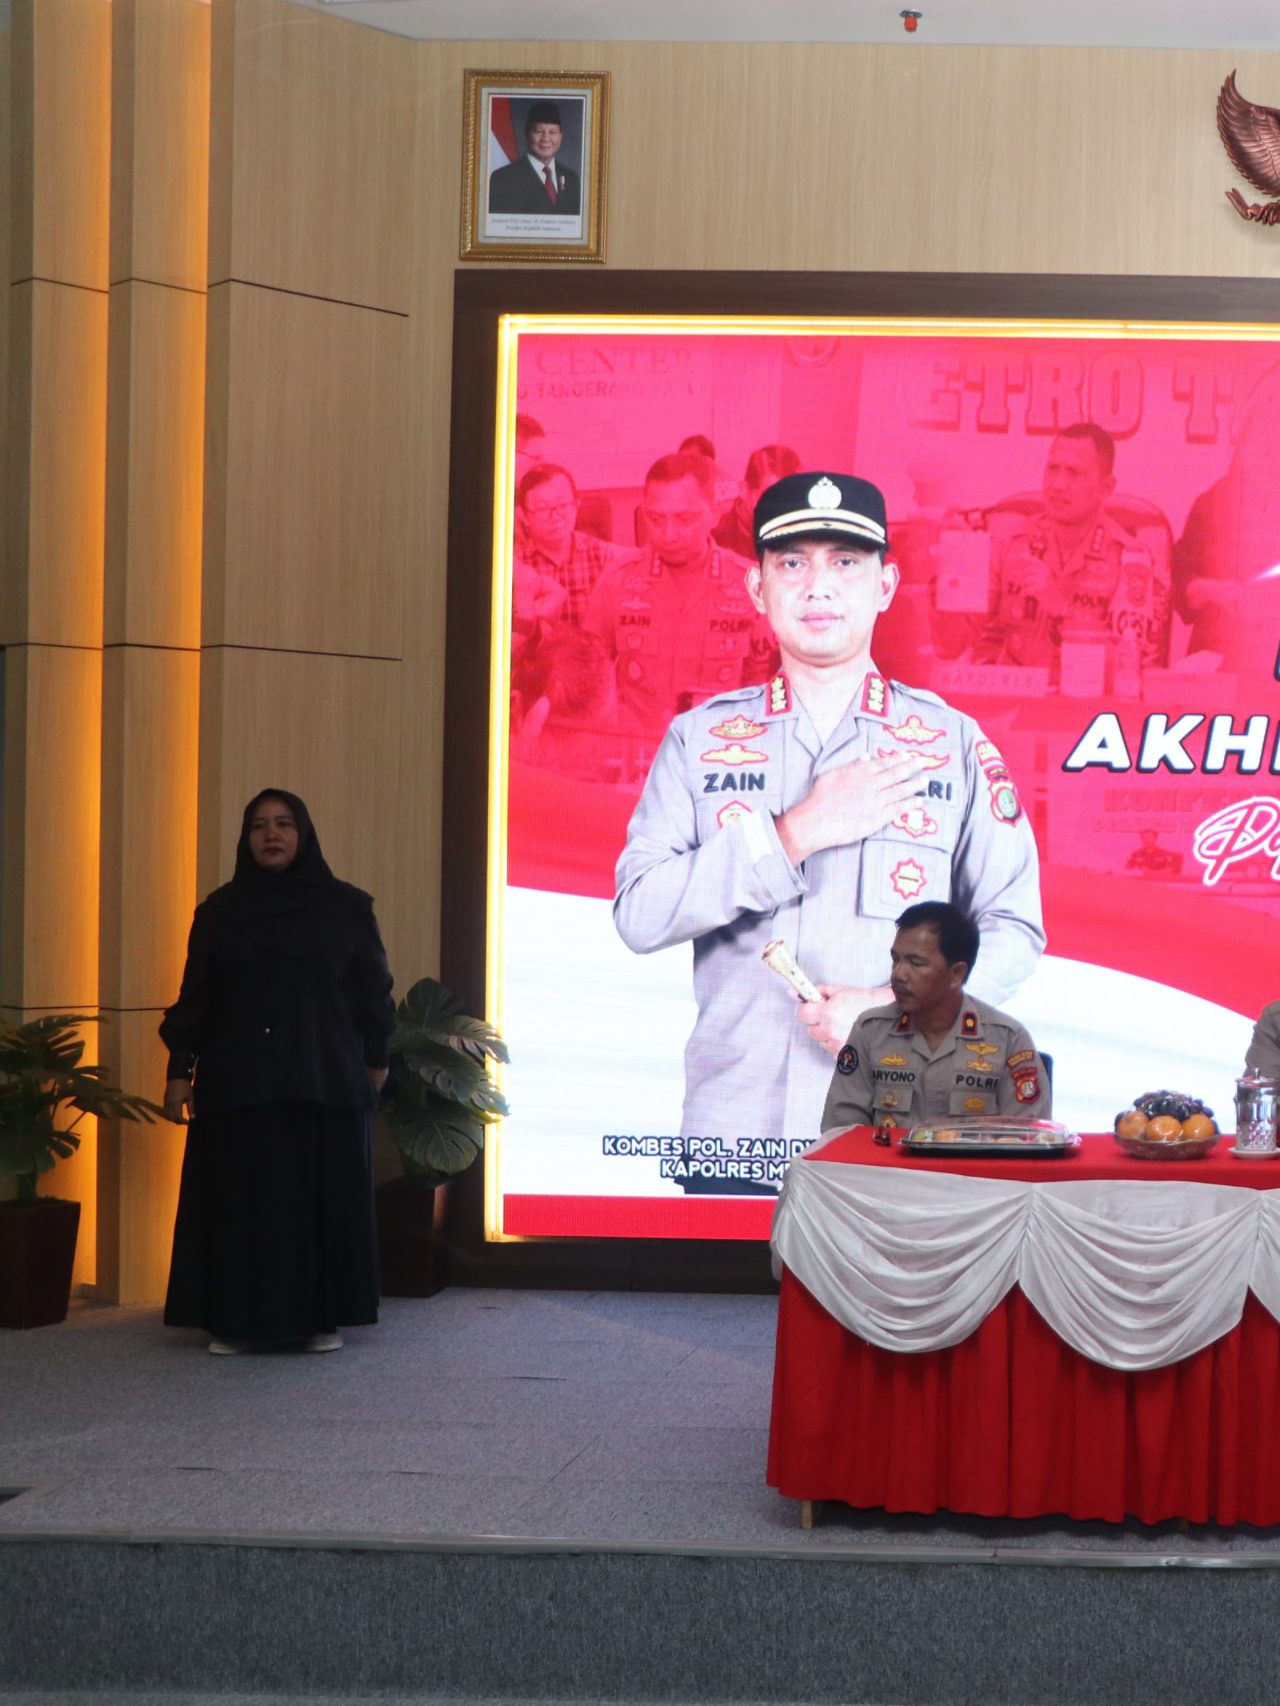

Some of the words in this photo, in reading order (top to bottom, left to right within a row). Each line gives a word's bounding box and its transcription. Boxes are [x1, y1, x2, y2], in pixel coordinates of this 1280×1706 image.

[619, 615, 652, 627] ZAIN
[703, 772, 766, 793] ZAIN
[955, 1074, 999, 1089] POLRI
[602, 1135, 685, 1157] KOMBES
[687, 1137, 734, 1158] POL.
[736, 1138, 786, 1158] ZAIN
[660, 1158, 764, 1180] KAPOLRES
